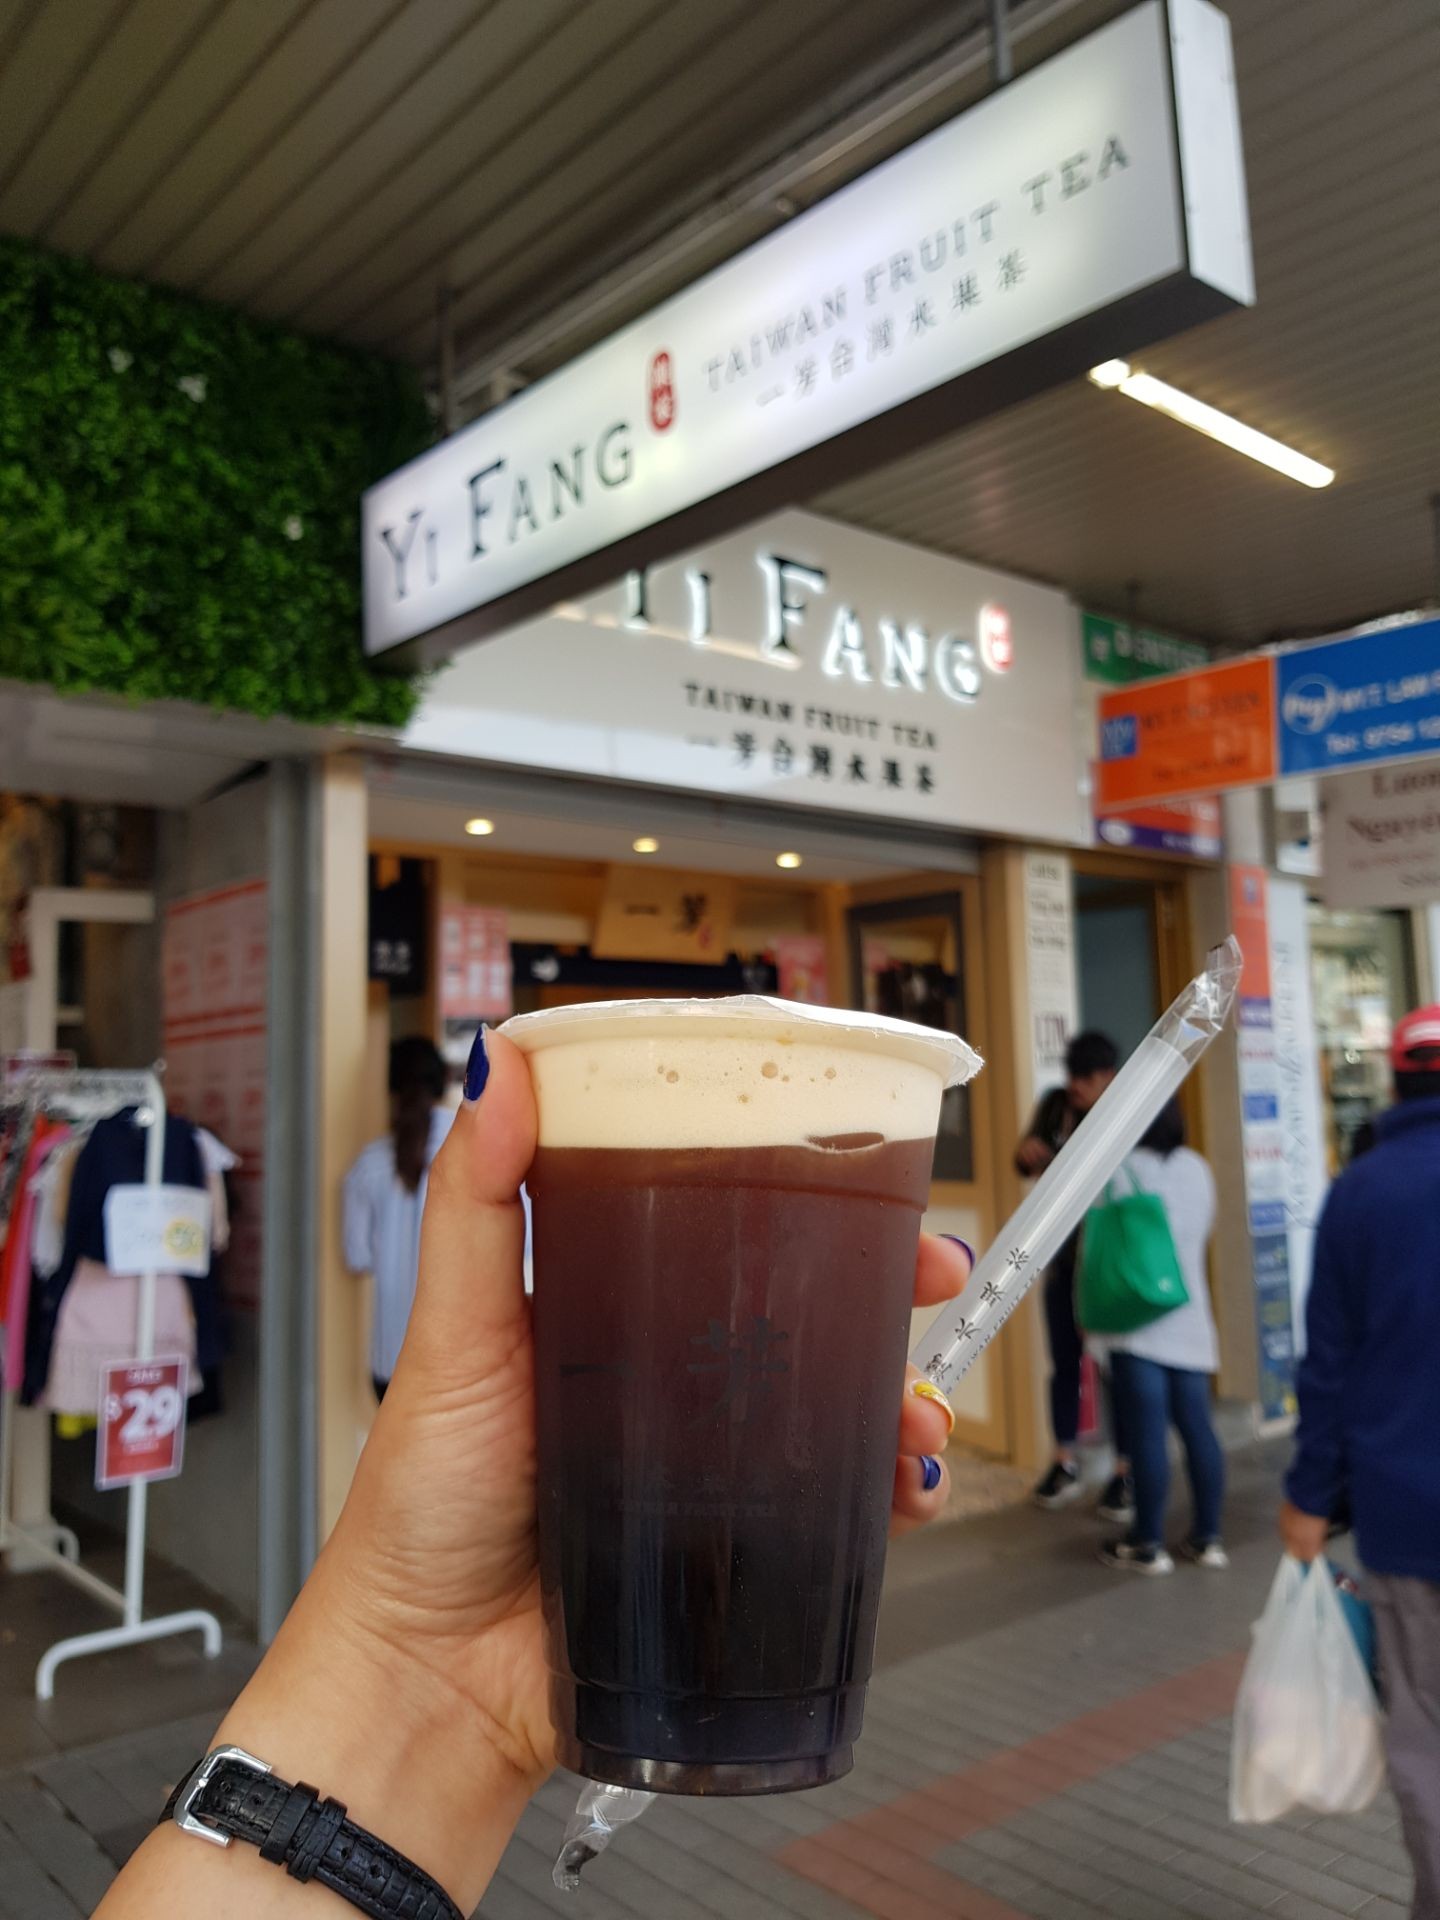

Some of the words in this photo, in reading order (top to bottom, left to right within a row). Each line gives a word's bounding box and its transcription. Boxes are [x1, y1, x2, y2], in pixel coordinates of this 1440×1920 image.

[704, 287, 847, 391] TAIWAN
[864, 200, 999, 305] FRUIT
[1021, 134, 1130, 215] TEA
[467, 421, 634, 561] FANG
[757, 552, 983, 703] FANG
[685, 683, 793, 723] TAIWAN
[804, 705, 881, 742] FRUIT
[893, 724, 938, 752] TEA
